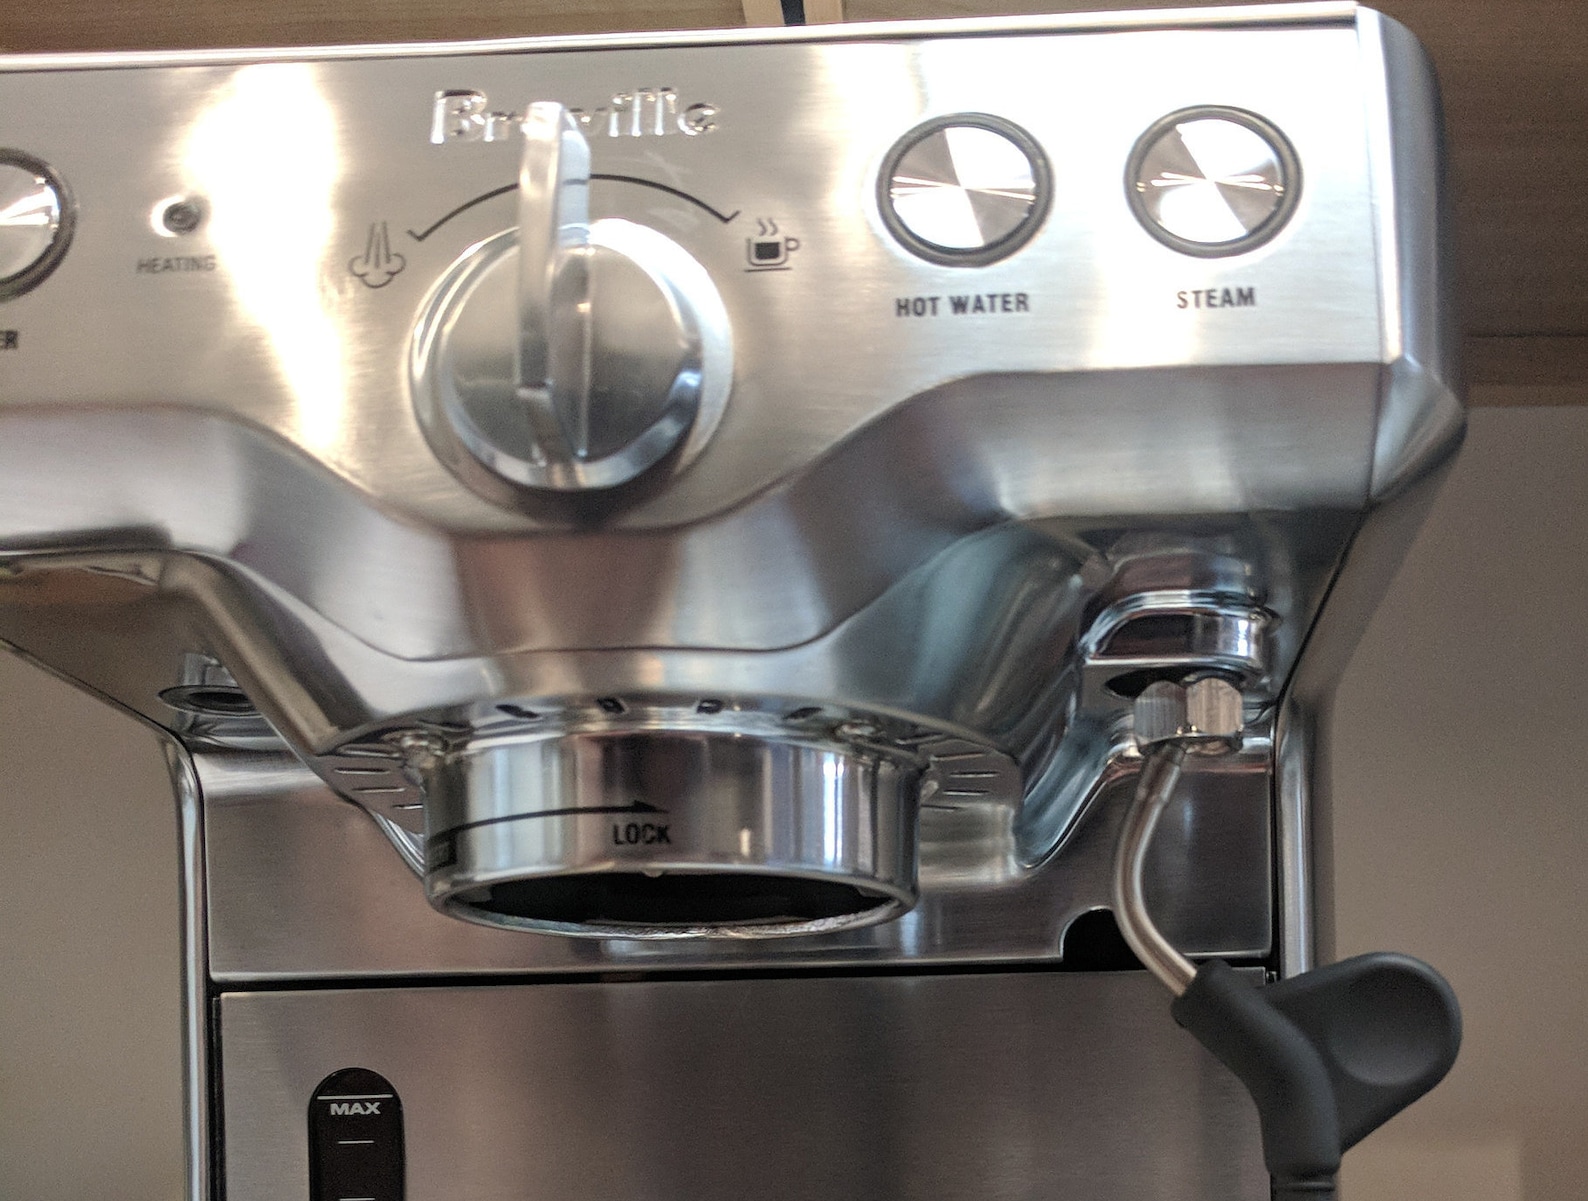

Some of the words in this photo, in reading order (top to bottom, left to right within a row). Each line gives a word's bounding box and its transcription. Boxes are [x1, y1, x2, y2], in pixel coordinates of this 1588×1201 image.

[430, 87, 720, 145] Brville
[136, 255, 217, 274] HEATING
[895, 296, 940, 317] HOT
[949, 293, 1029, 315] WATER
[1177, 287, 1255, 309] STEAM
[613, 823, 671, 845] LOCK
[330, 1102, 381, 1116] MAX
